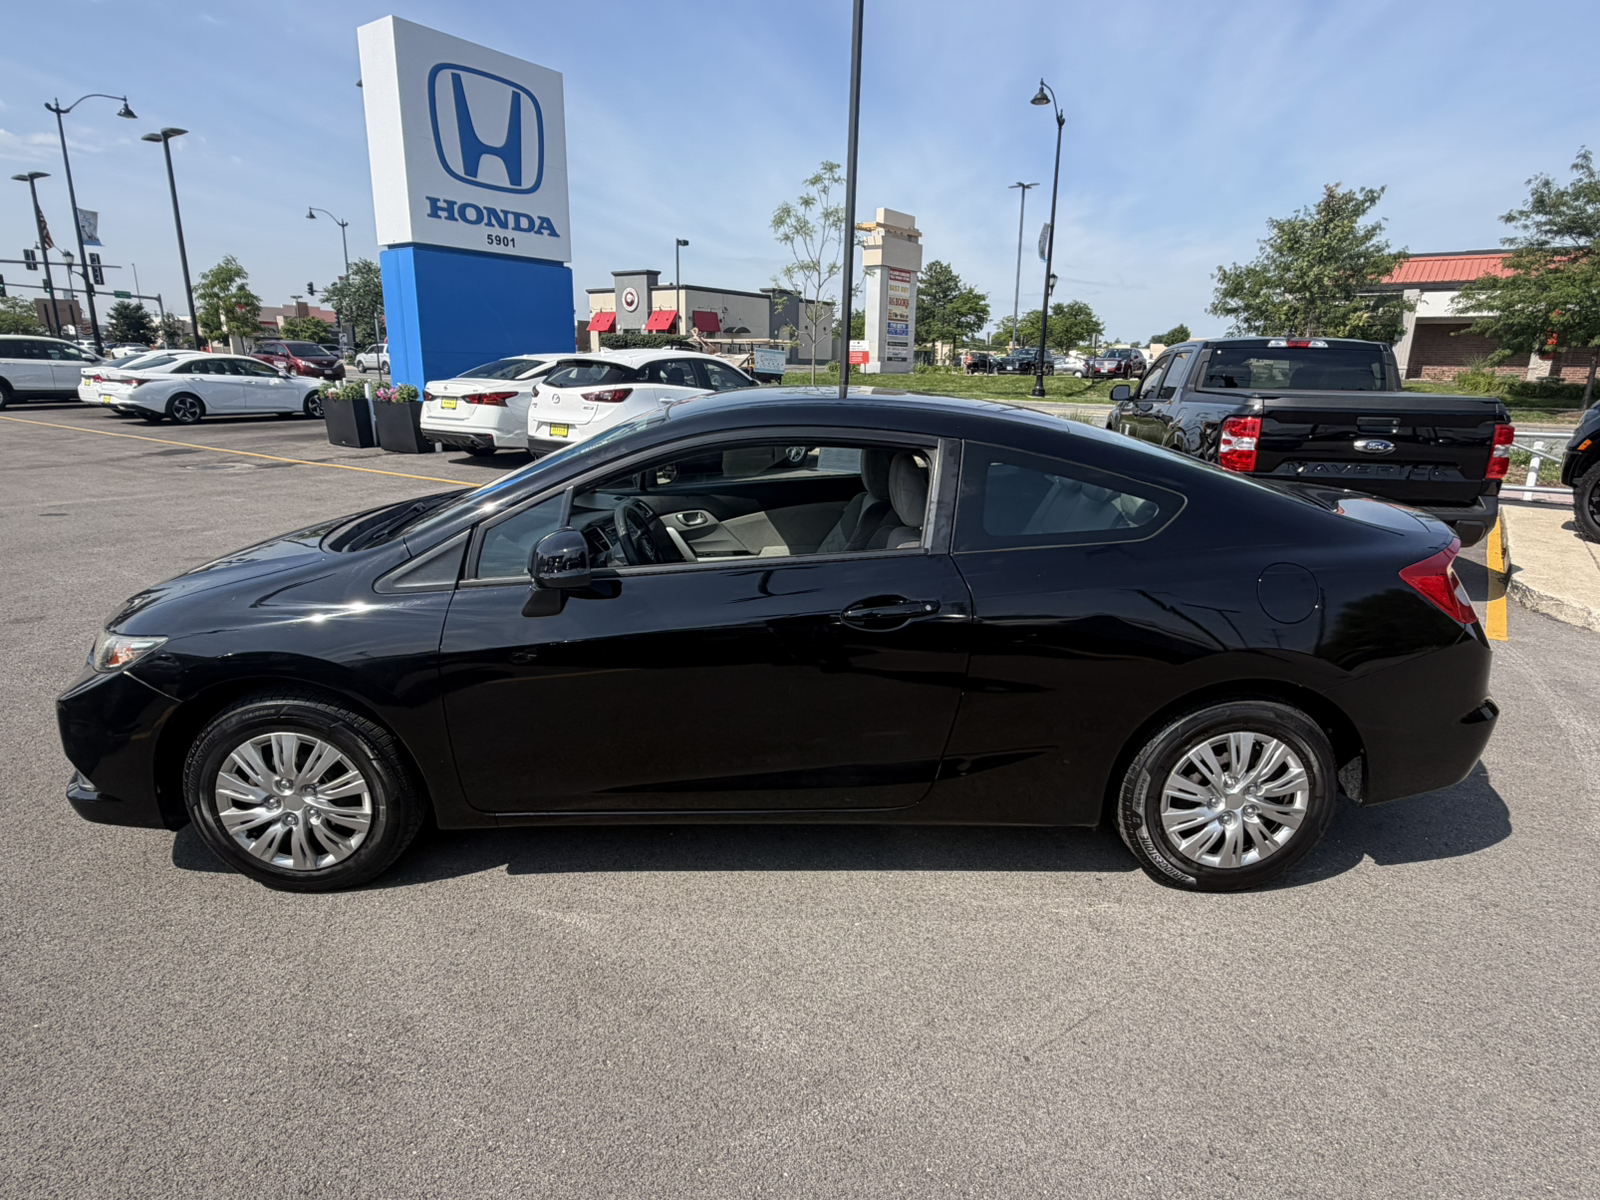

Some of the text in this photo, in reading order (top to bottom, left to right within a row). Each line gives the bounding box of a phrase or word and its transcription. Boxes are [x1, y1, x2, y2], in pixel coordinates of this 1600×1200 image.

[425, 195, 561, 238] HONDA
[486, 233, 516, 248] 5901
[1286, 462, 1449, 477] MAVERICK
[1140, 834, 1191, 882] BRIDGESTONE
